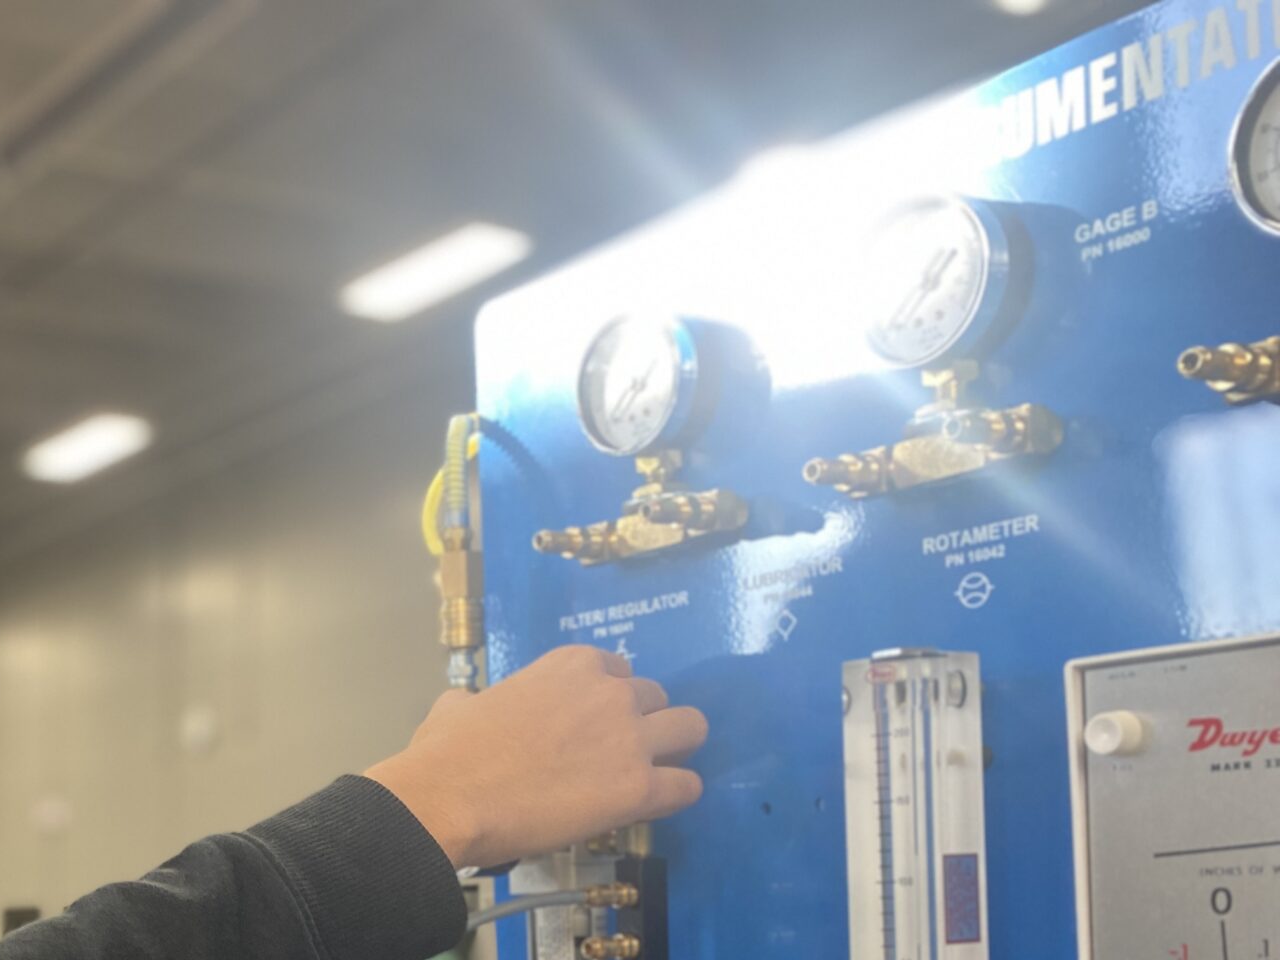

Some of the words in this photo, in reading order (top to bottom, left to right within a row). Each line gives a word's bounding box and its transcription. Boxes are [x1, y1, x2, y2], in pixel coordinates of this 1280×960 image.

[1075, 205, 1137, 243] GAGE
[1142, 200, 1159, 221] B
[1081, 243, 1104, 261] PN
[922, 514, 1040, 555] ROTAMETER
[944, 554, 965, 568] PN
[607, 590, 689, 621] REGULATOR
[1211, 761, 1252, 772] MARK
[1211, 887, 1233, 915] 0
